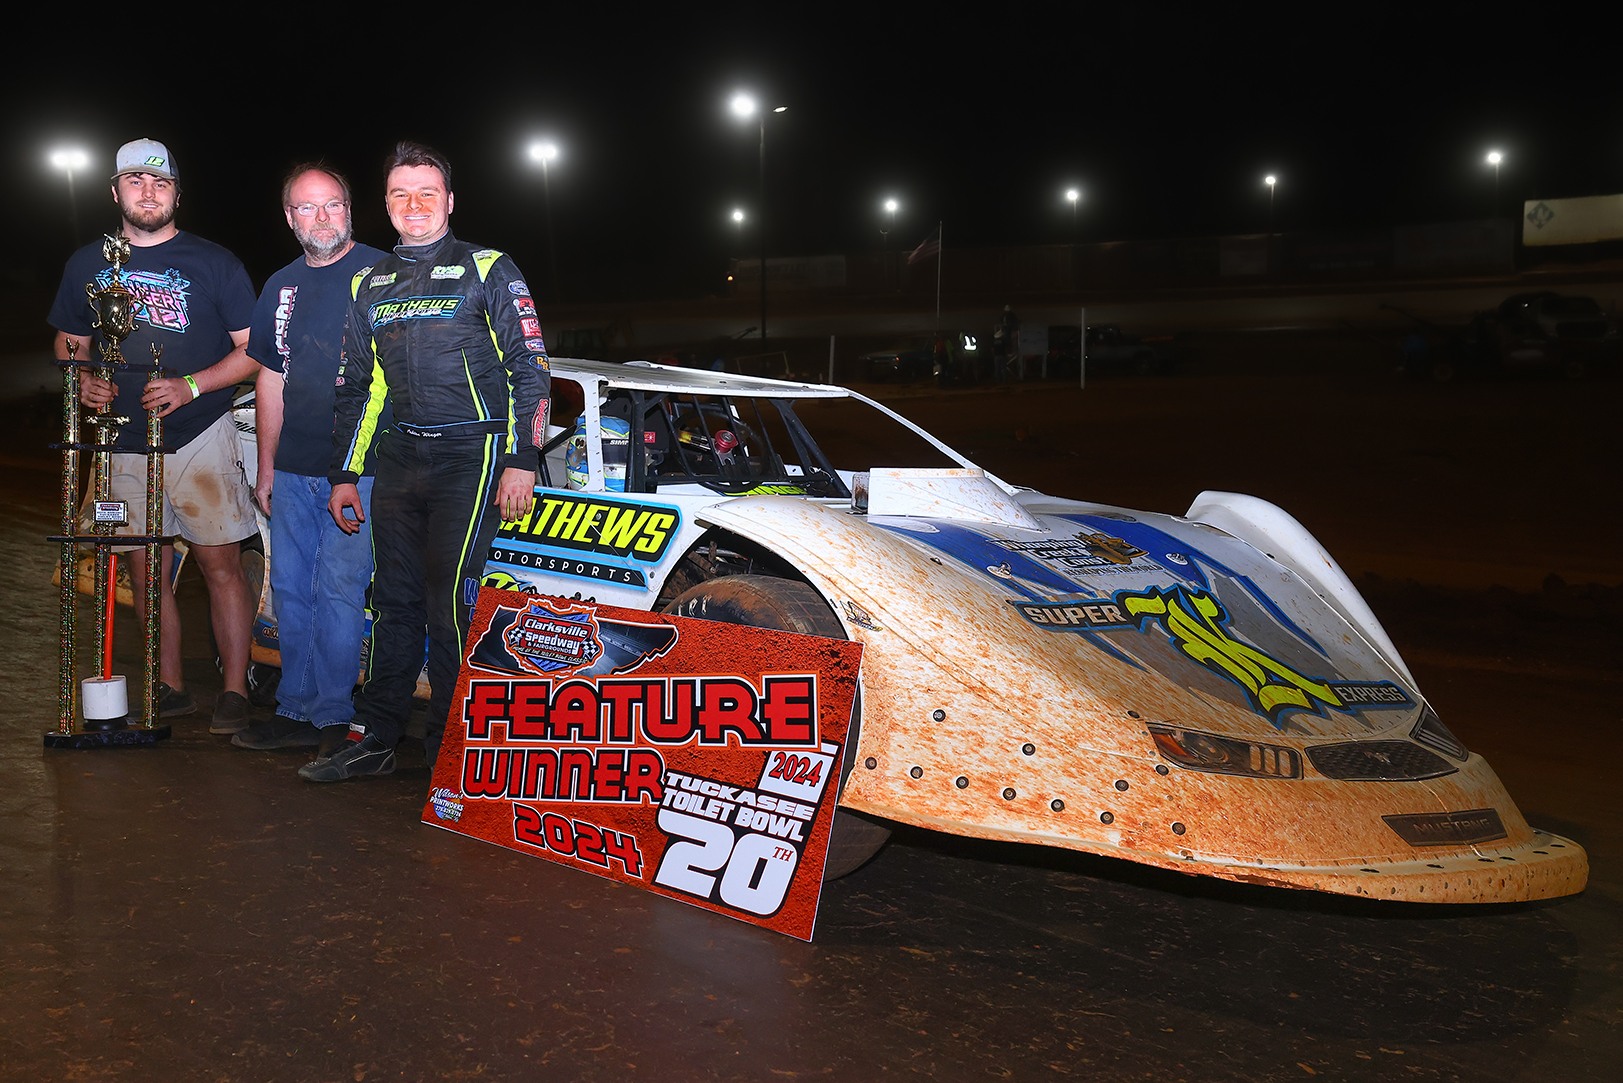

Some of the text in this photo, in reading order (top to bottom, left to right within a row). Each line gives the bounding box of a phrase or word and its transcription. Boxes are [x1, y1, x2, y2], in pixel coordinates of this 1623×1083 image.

[373, 299, 459, 321] MATHEWS
[500, 498, 677, 553] ATHEWS
[494, 550, 632, 582] OTORSPORTS
[524, 618, 589, 638] Clarksville
[1023, 605, 1127, 625] SUPER
[525, 631, 580, 655] Speedway
[533, 642, 573, 655] FAIRGROUNDS
[1337, 685, 1407, 706] EXPRESS
[466, 678, 820, 746] FEATURE
[464, 749, 667, 803] WINNER
[768, 752, 822, 788] 2024
[430, 796, 464, 811] PRINTWORKS
[666, 772, 814, 821] TUCKASEE
[663, 789, 806, 842] TOILET BOWL
[514, 803, 643, 878] 2024
[772, 844, 795, 863] TH
[655, 811, 798, 917] 20
